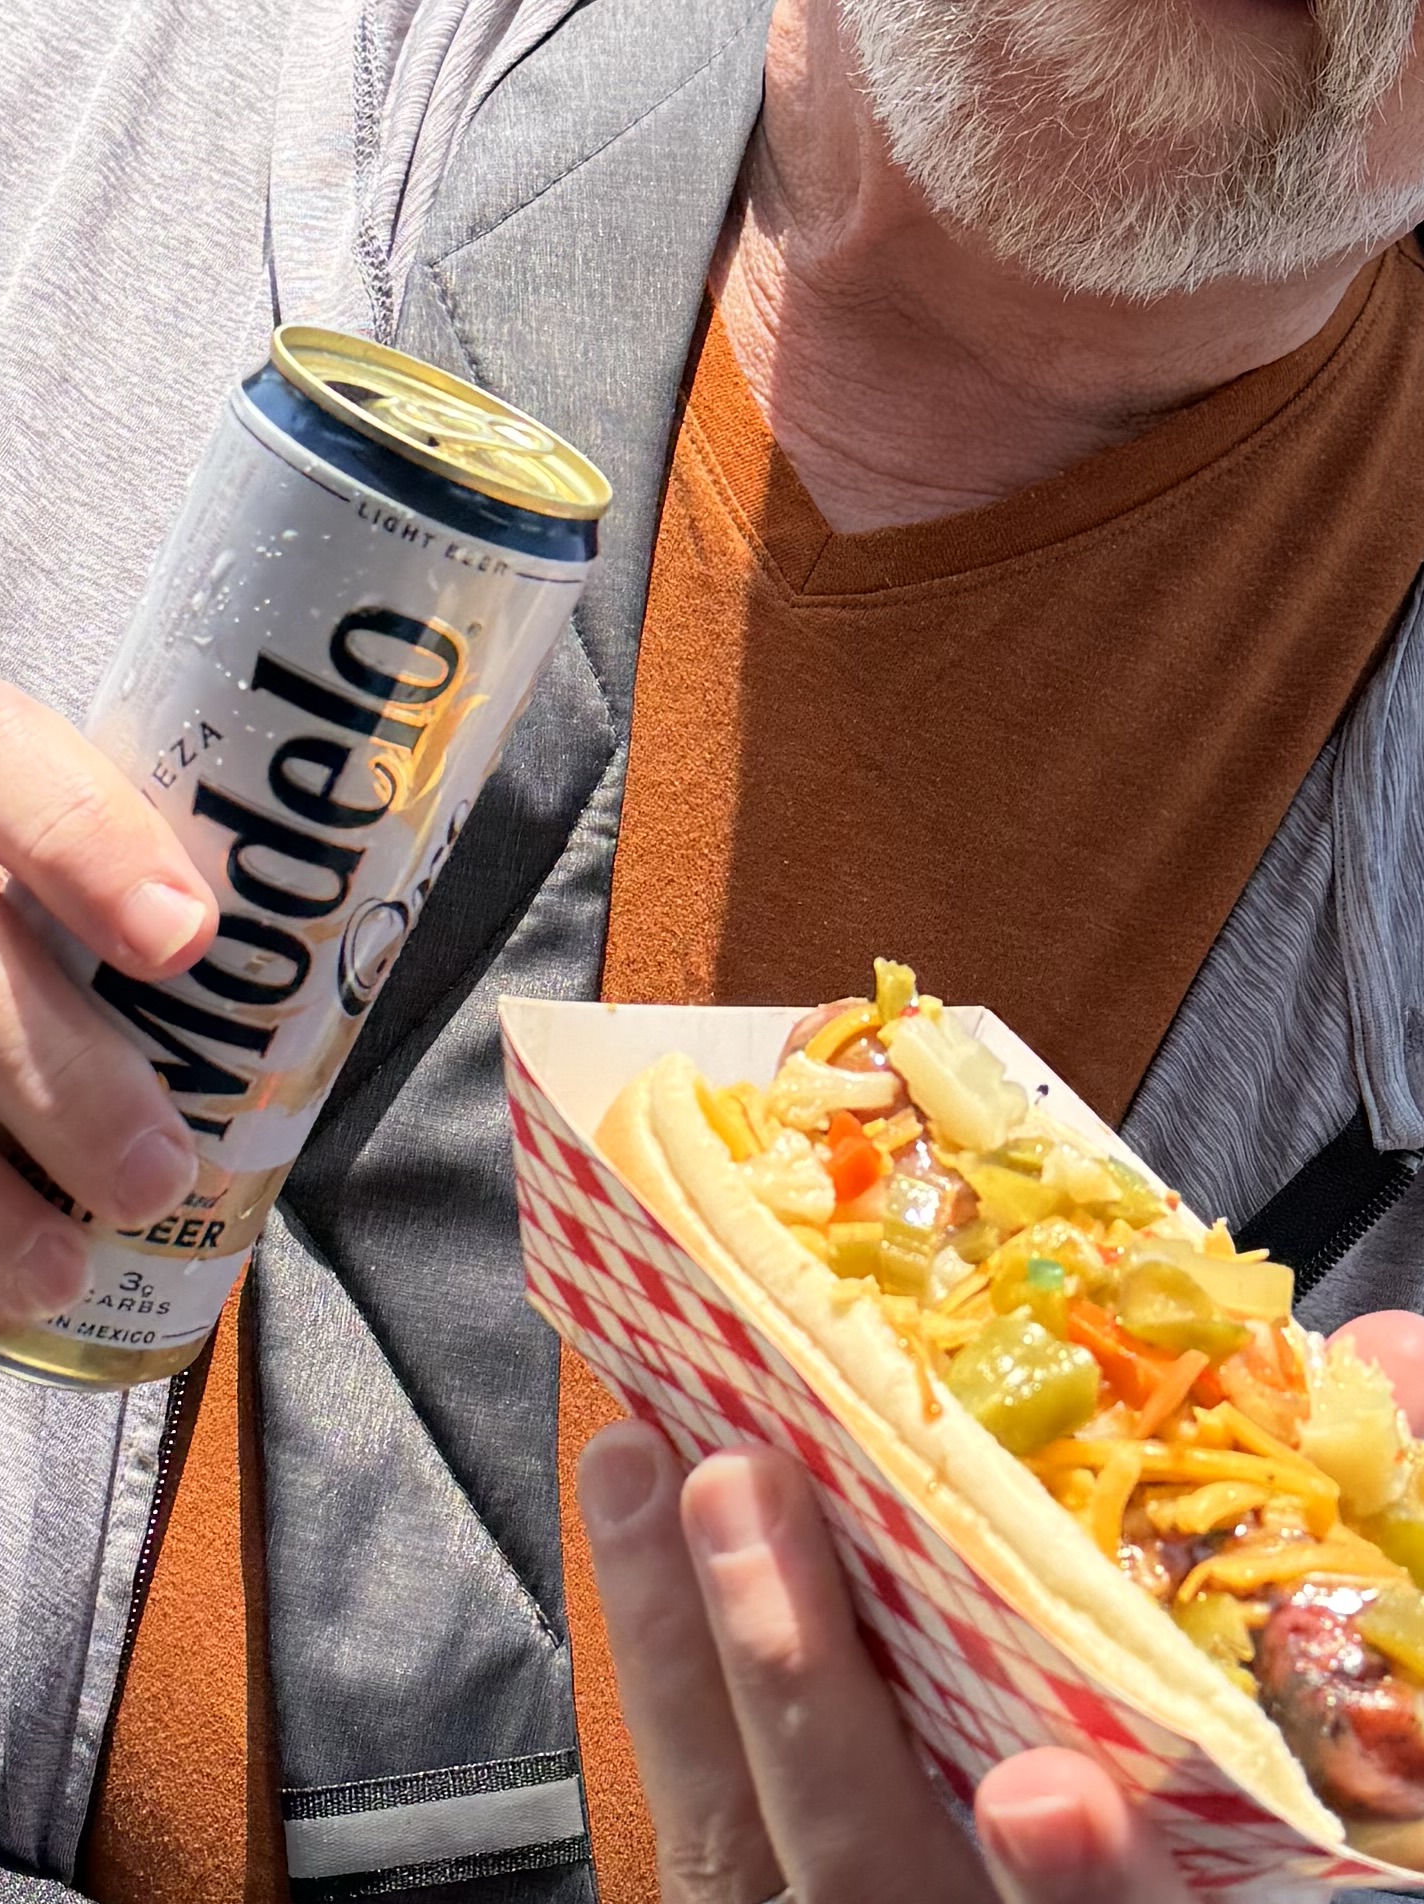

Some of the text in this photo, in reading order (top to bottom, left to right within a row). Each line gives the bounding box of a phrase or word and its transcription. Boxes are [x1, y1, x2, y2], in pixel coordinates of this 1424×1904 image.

[358, 502, 436, 549] LIGHT
[91, 604, 466, 1144] Modelo
[117, 1216, 226, 1249] EER
[77, 1322, 157, 1345] MEXICO
